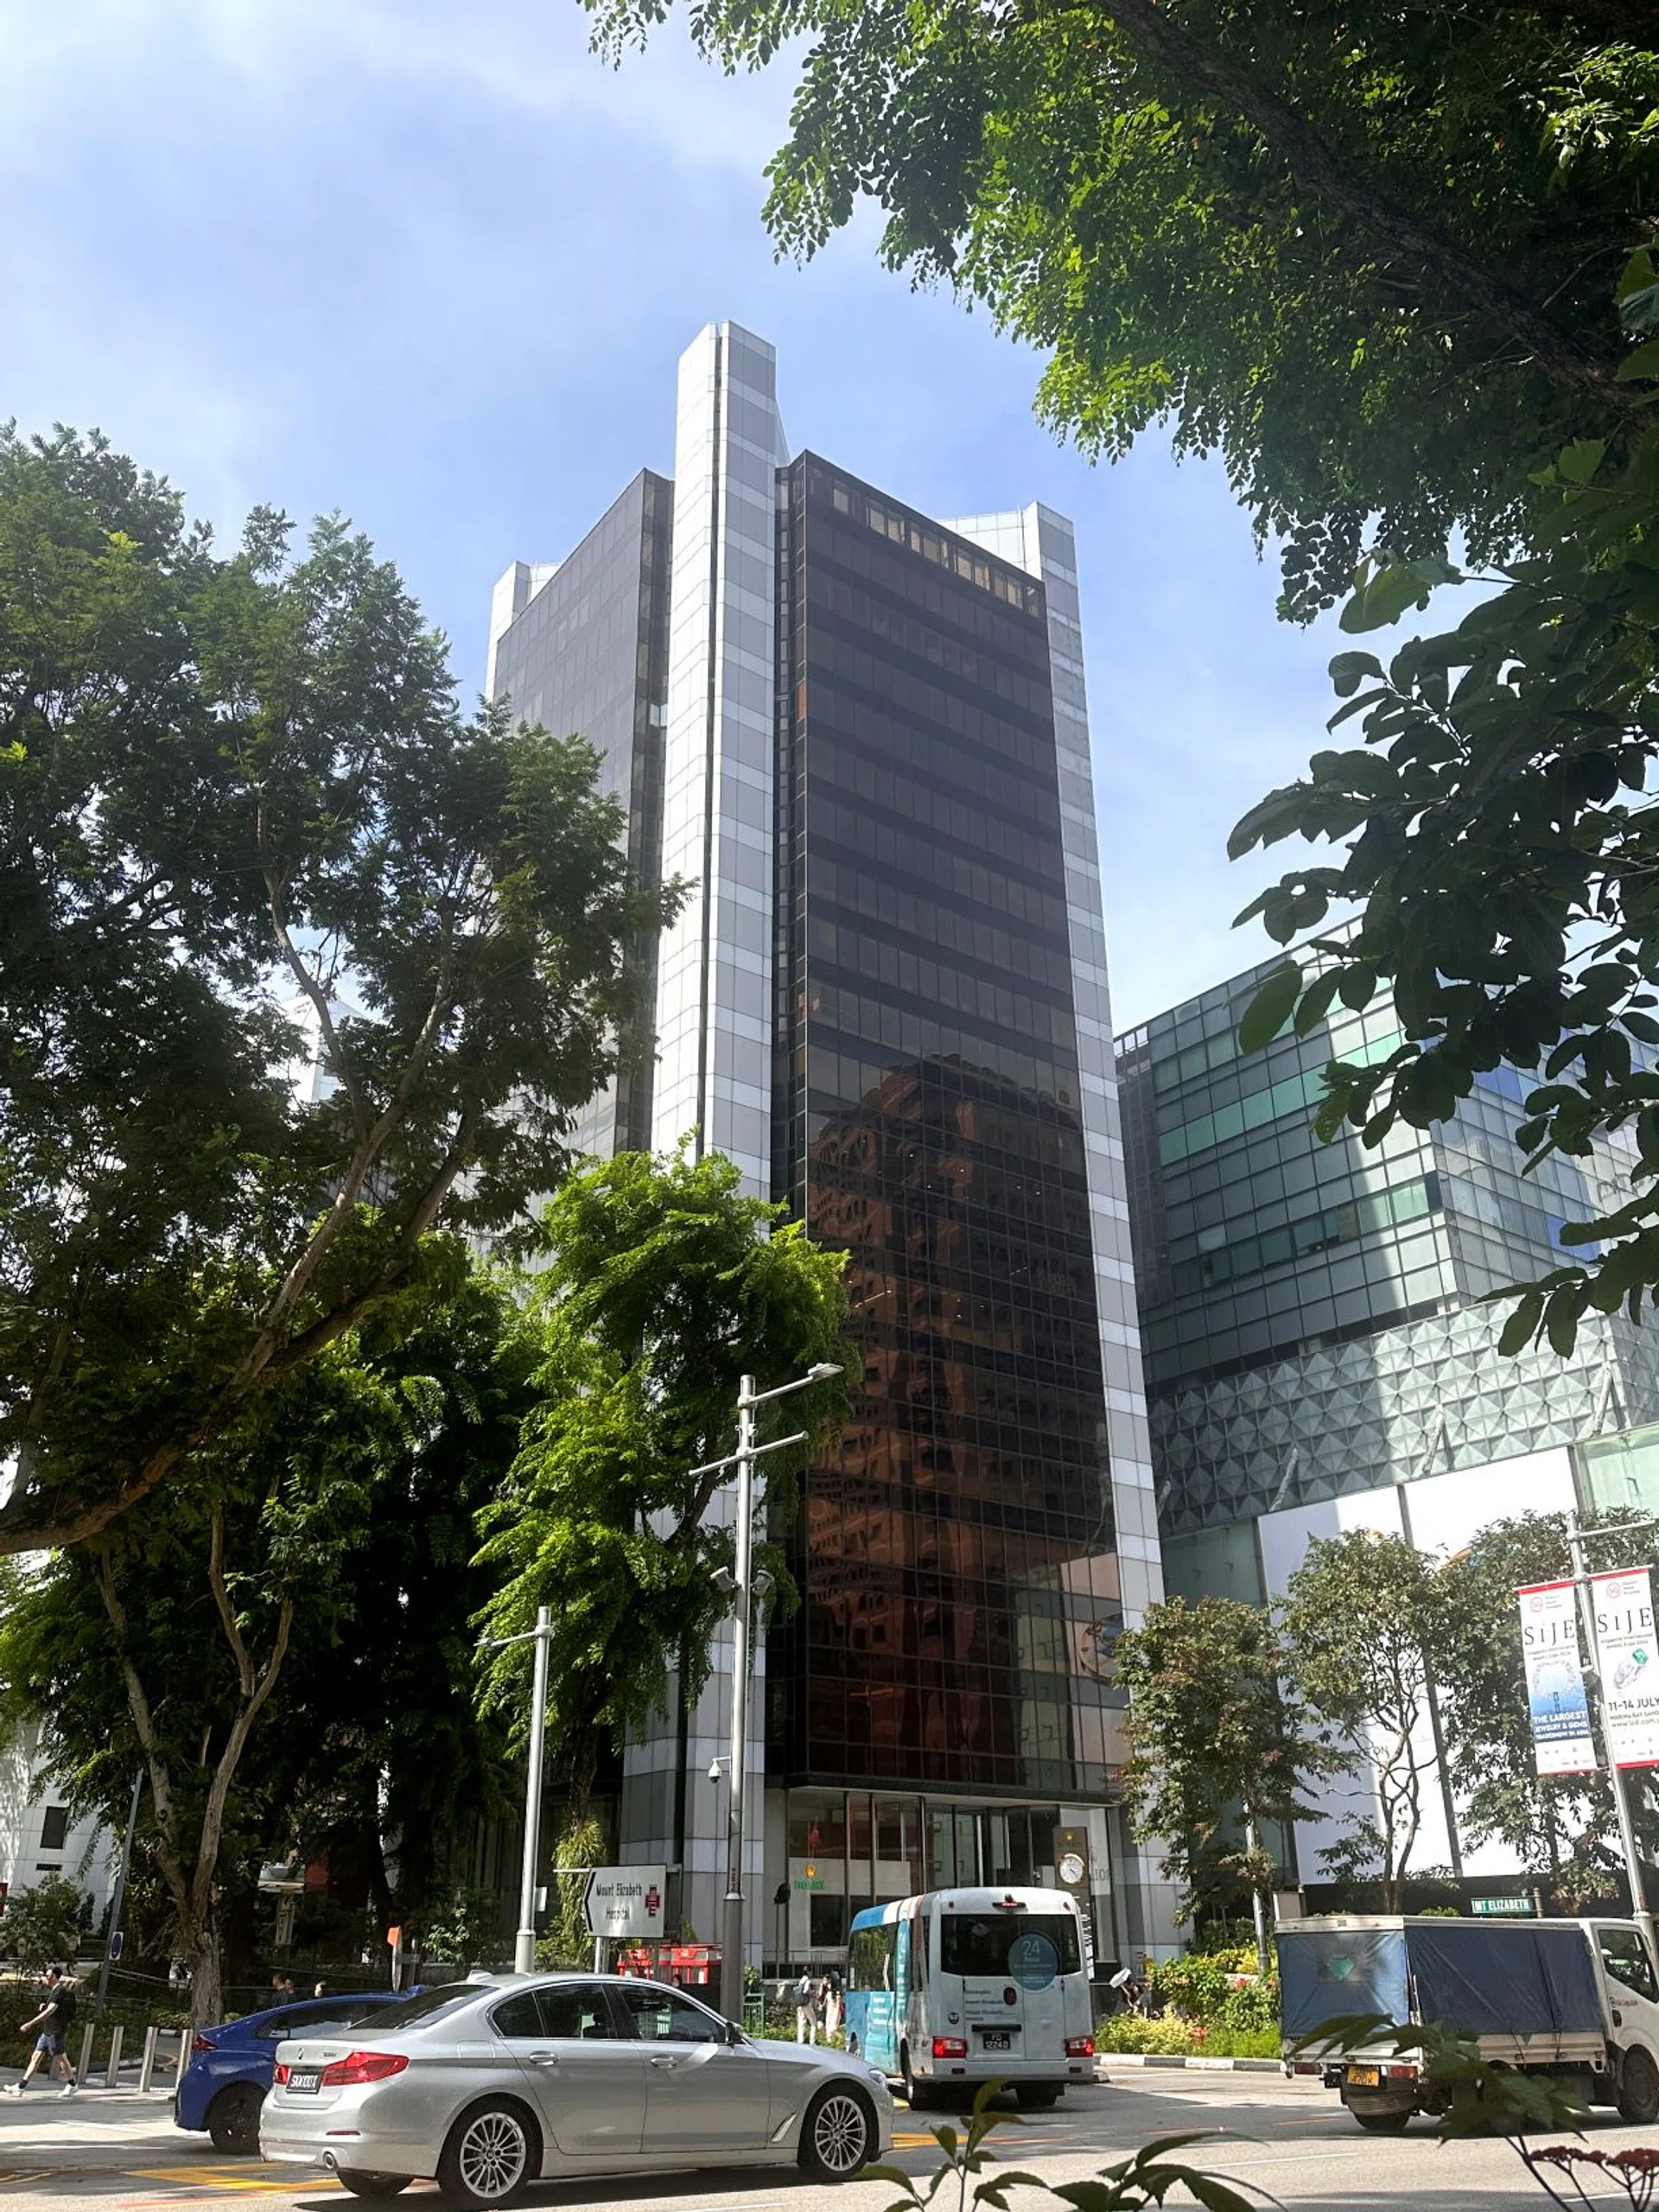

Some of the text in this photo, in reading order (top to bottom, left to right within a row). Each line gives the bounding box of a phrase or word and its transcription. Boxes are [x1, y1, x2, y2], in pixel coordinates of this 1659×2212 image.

[1637, 1697, 1659, 1709] JULY
[1533, 1711, 1587, 1726] THE LARGEST
[596, 1883, 642, 1897] Mount Elizabeth
[1474, 1898, 1530, 1911] MT ELIZABETH
[606, 1906, 630, 1920] Hospital
[1022, 1940, 1040, 1955] 24
